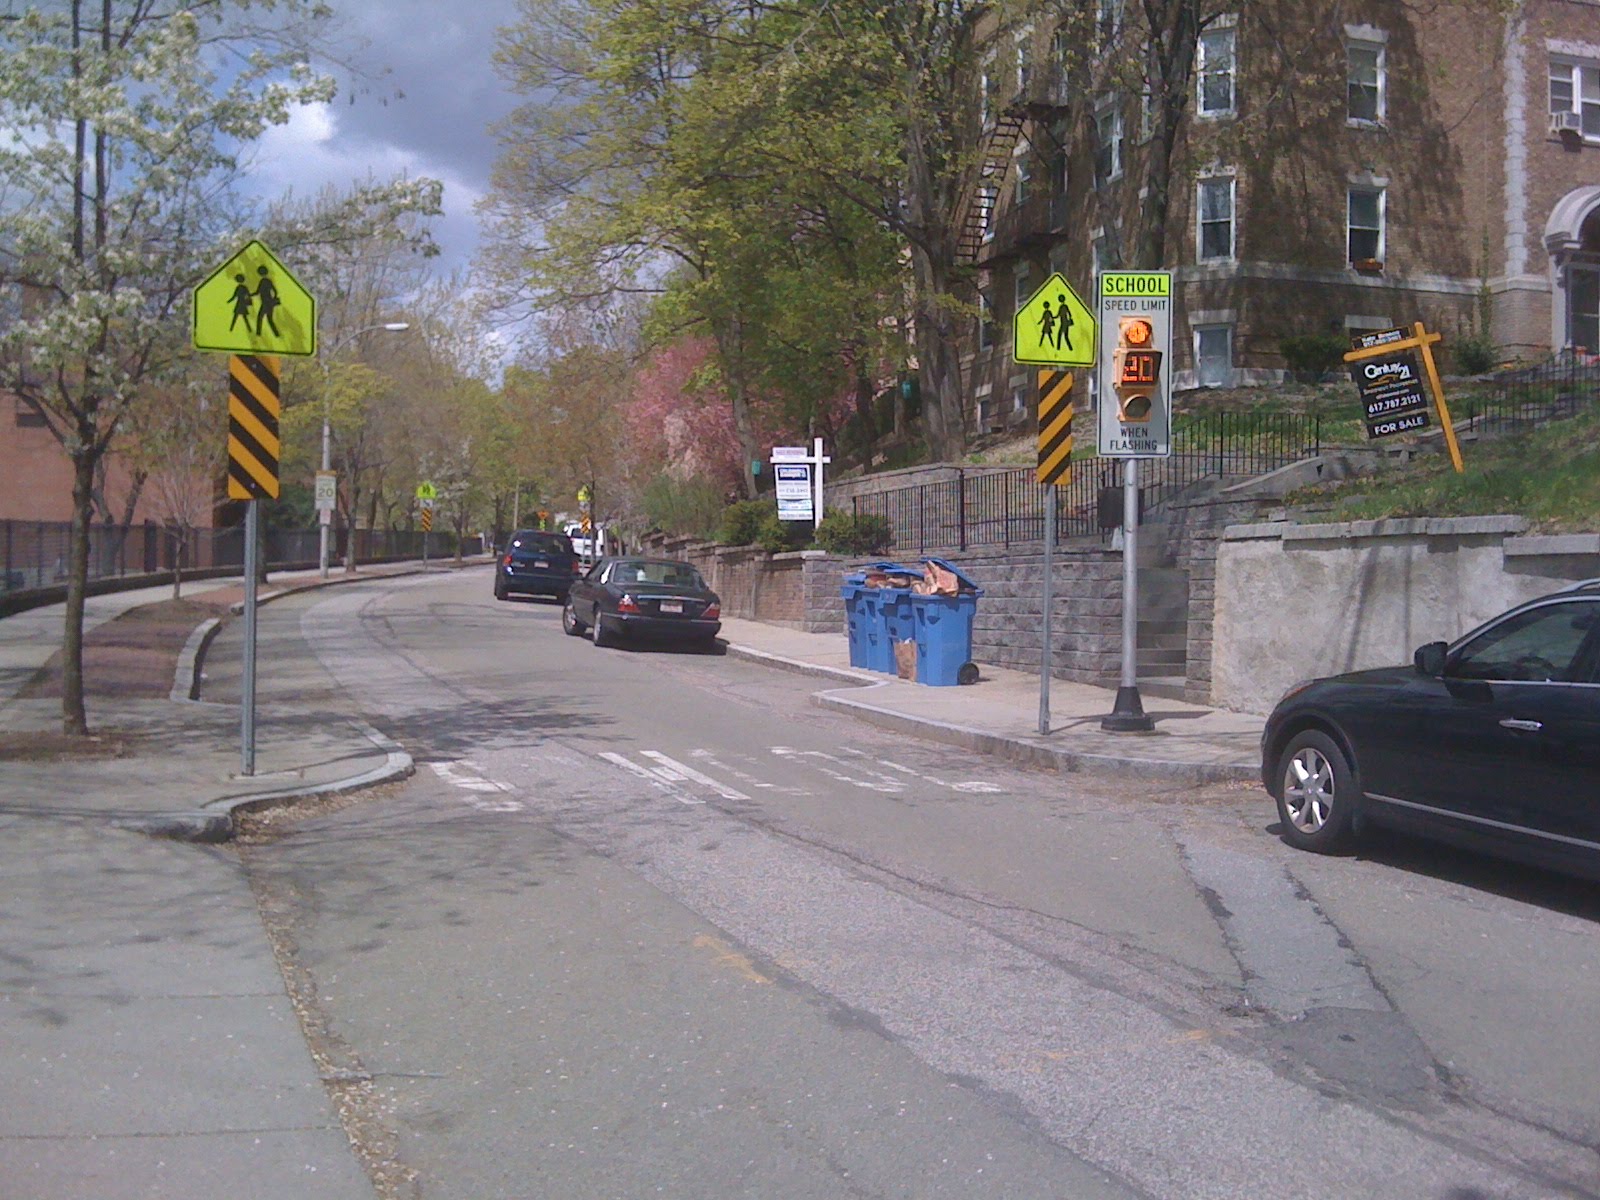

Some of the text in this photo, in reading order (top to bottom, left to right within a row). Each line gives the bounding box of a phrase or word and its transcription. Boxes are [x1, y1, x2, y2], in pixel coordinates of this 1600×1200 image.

[1105, 277, 1167, 293] SCHOOL
[1104, 300, 1167, 311] SPEED LIMIT
[1122, 355, 1154, 382] 20
[1364, 361, 1412, 380] Century 21
[1368, 393, 1421, 413] 617.787.2121
[1120, 427, 1148, 438] WHEN
[1374, 416, 1425, 436] FOR SALE
[1109, 440, 1158, 451] FLASHING
[318, 487, 334, 498] 20
